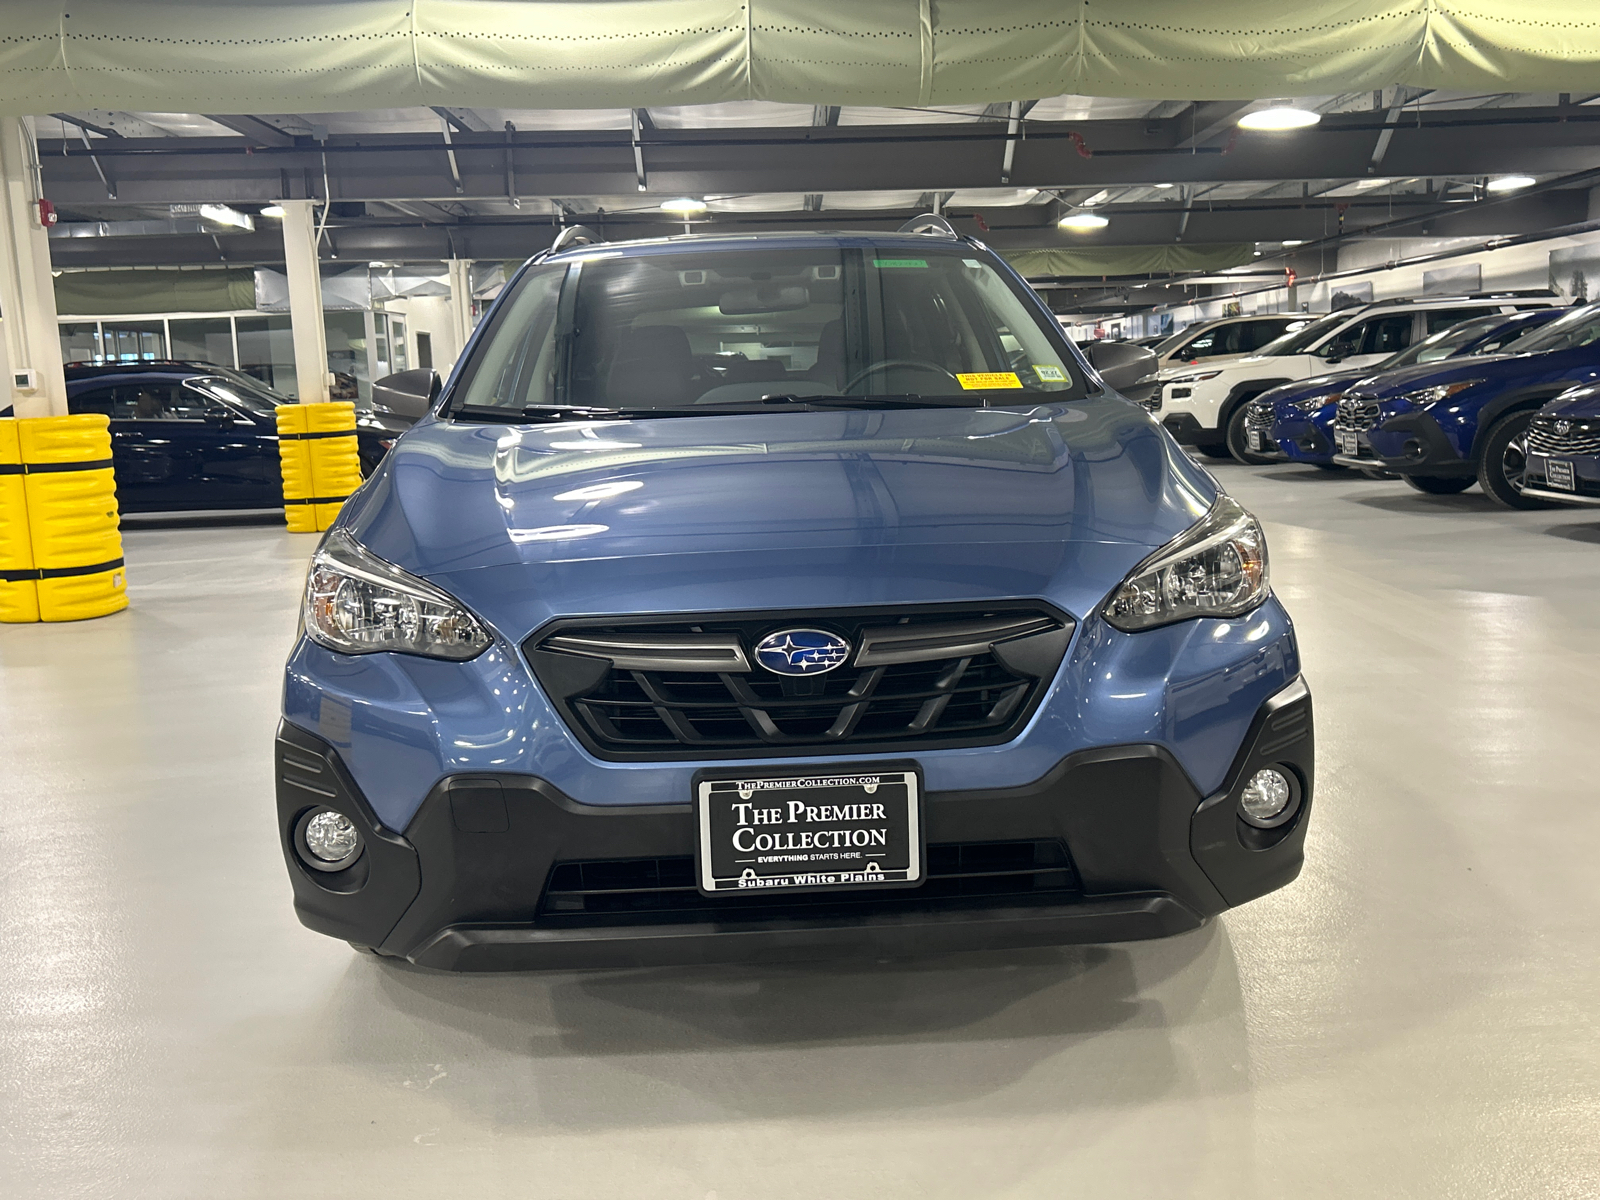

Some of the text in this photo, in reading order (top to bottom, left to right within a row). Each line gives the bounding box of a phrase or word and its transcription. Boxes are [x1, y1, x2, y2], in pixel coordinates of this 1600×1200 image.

[736, 776, 880, 790] THEPREMIERCOLLECTION.COM
[731, 800, 887, 826] THE PREMIER
[732, 827, 887, 852] COLLECTION
[757, 852, 863, 863] EVERYTHING STARTS HERE.
[738, 871, 885, 888] Subaru White Plains
